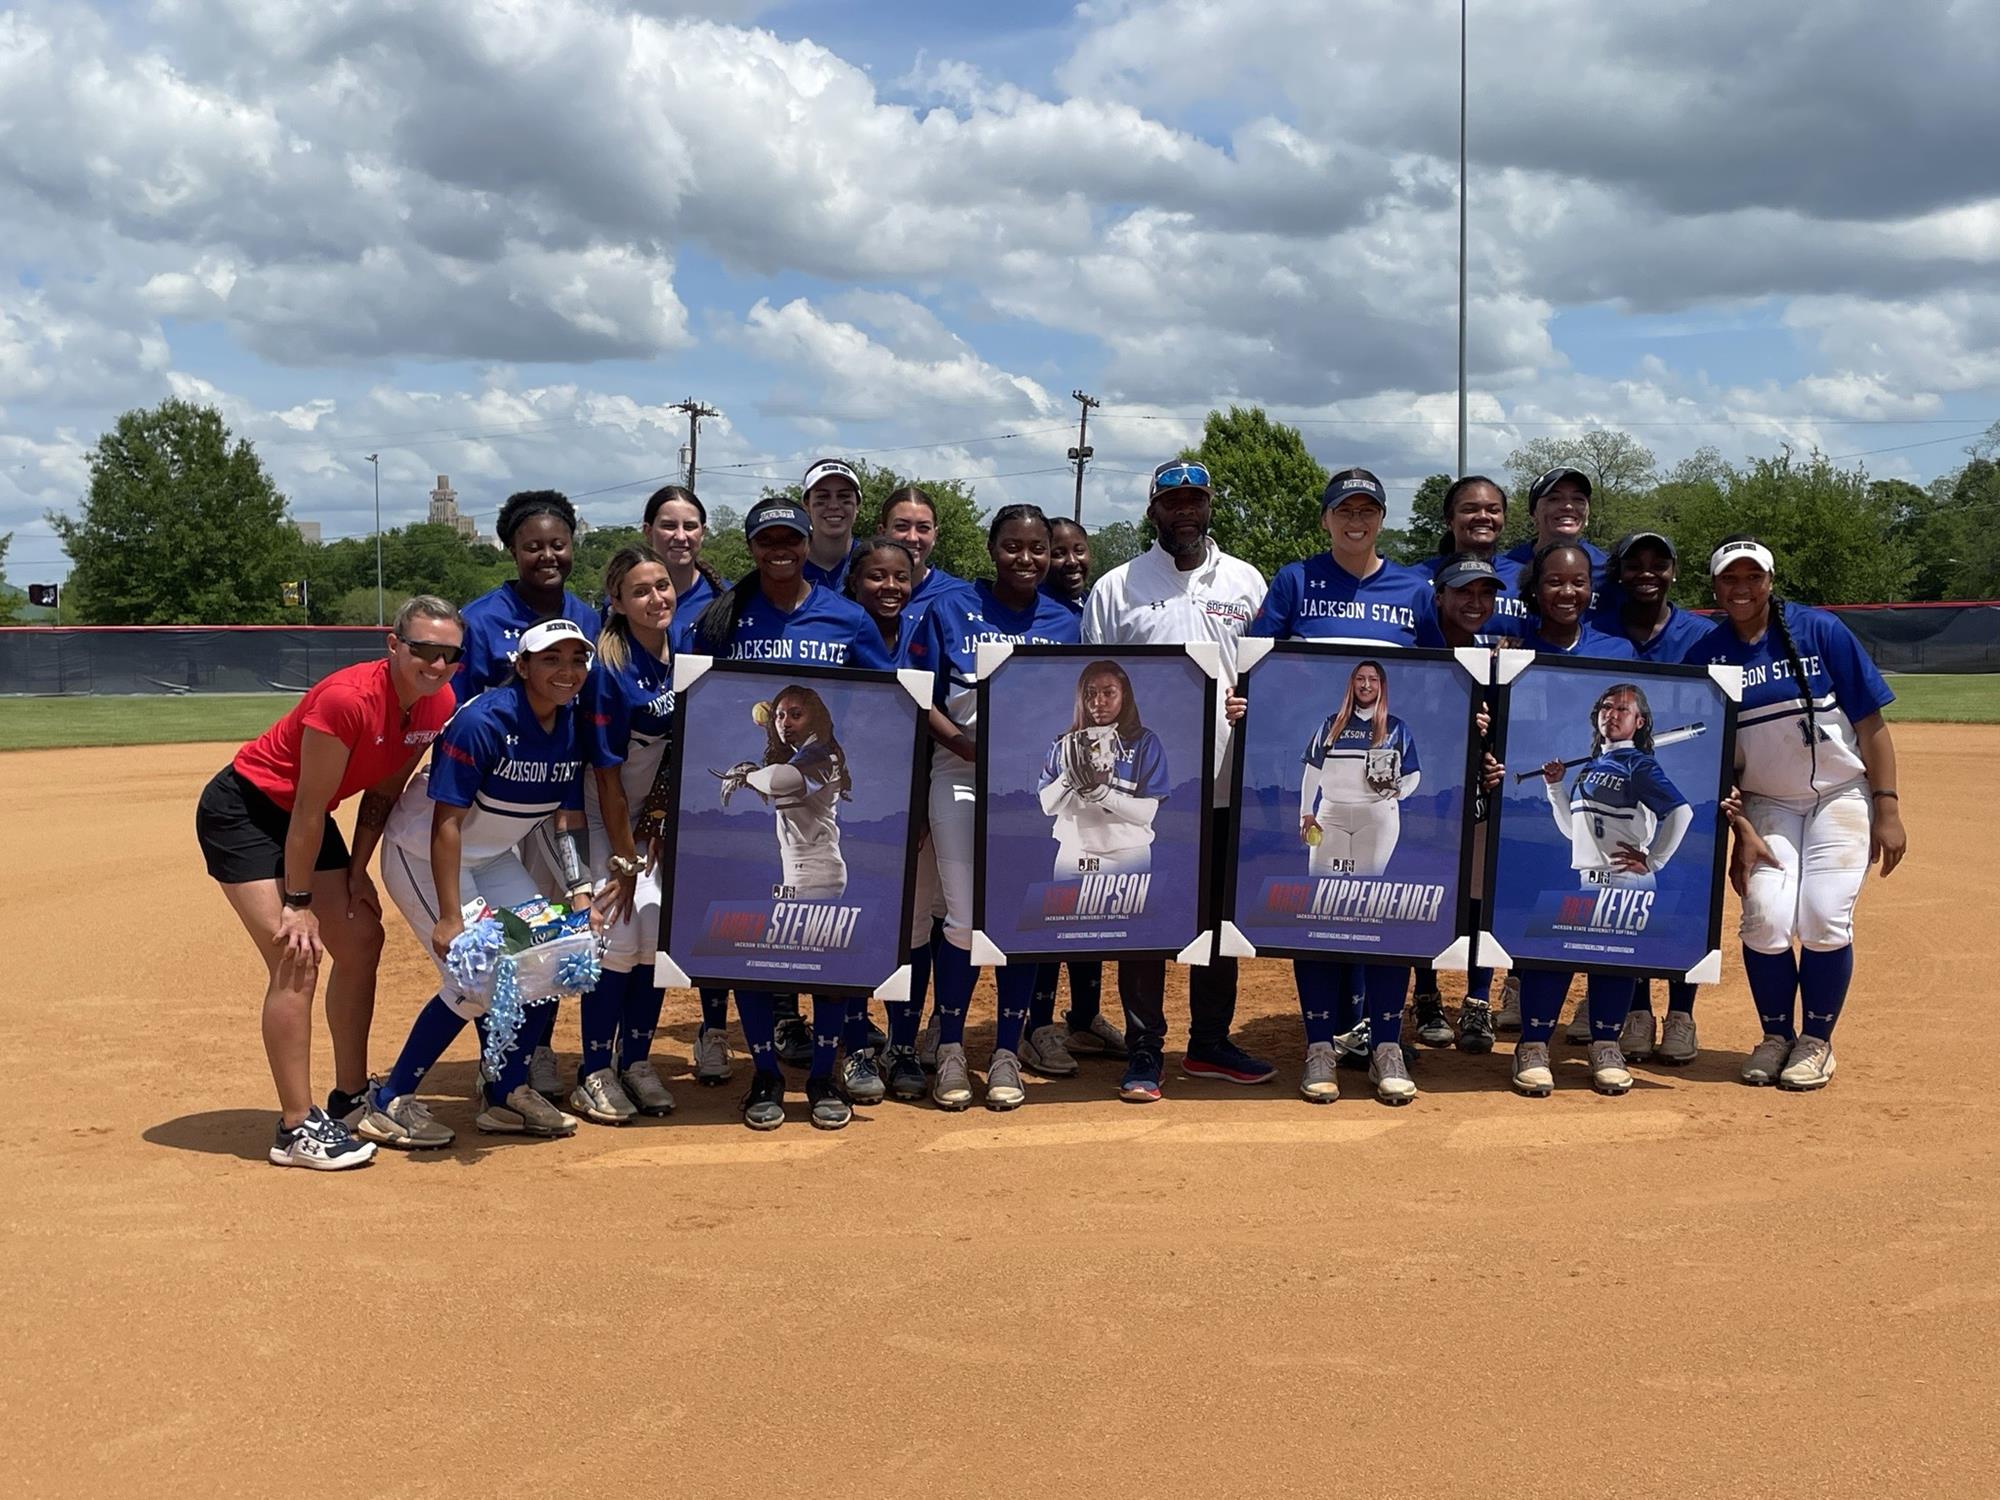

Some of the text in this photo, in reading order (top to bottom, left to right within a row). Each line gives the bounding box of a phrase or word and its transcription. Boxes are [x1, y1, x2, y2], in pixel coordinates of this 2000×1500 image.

[1206, 601, 1245, 617] SOFTBALL
[1300, 598, 1415, 629] JACKSON STATE
[1495, 596, 1528, 620] TATE
[727, 639, 847, 664] JACKSON STATE
[1772, 656, 1821, 680] STTE
[647, 690, 675, 717] JACKS
[493, 757, 582, 783] JACKSON STAT
[1589, 771, 1625, 791] STATE
[1594, 815, 1605, 839] 6
[1075, 873, 1151, 914] HOPSON
[1311, 878, 1445, 922] KUPPENBENDER
[1590, 887, 1655, 931] KEYES
[766, 902, 862, 948] STEWART
